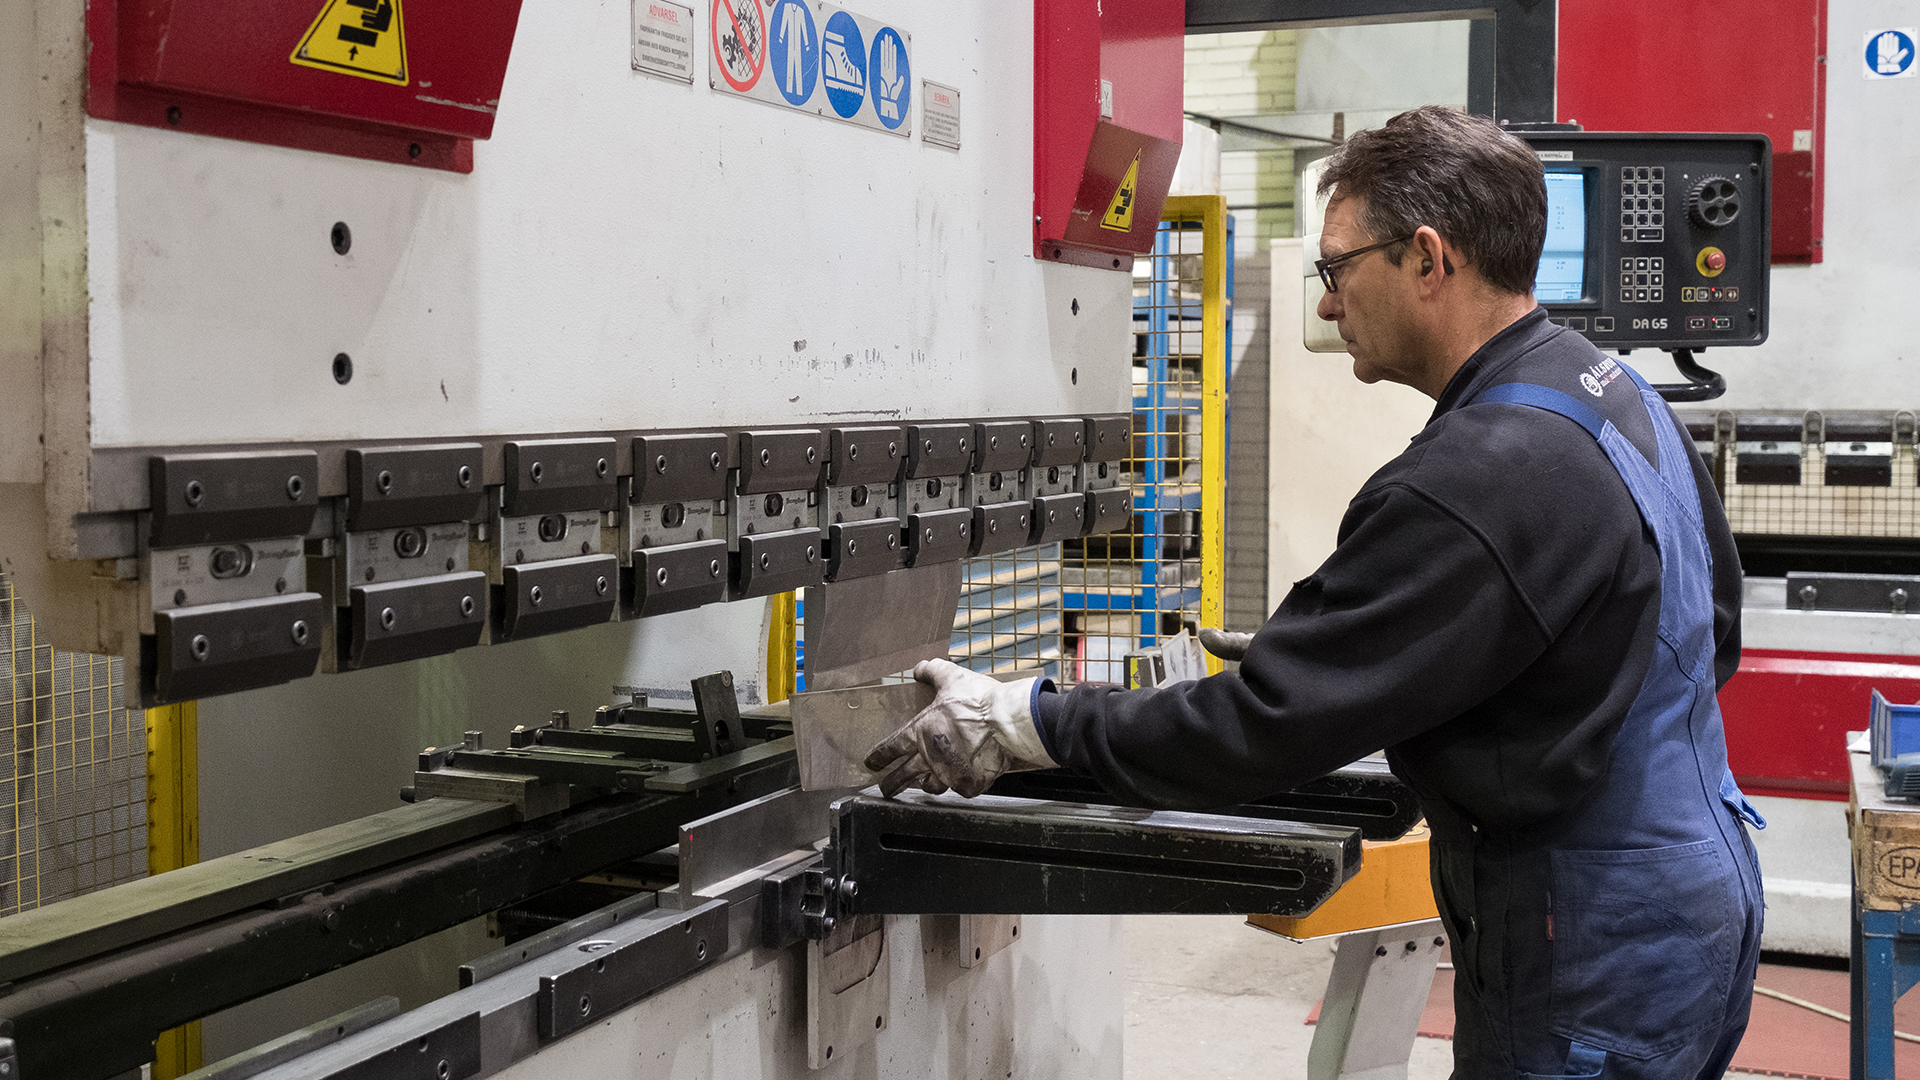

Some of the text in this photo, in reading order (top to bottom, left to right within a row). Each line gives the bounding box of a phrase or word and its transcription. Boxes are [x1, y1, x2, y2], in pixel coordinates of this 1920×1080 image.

[649, 4, 678, 23] ADVARSEL
[1633, 318, 1668, 330] DA 65
